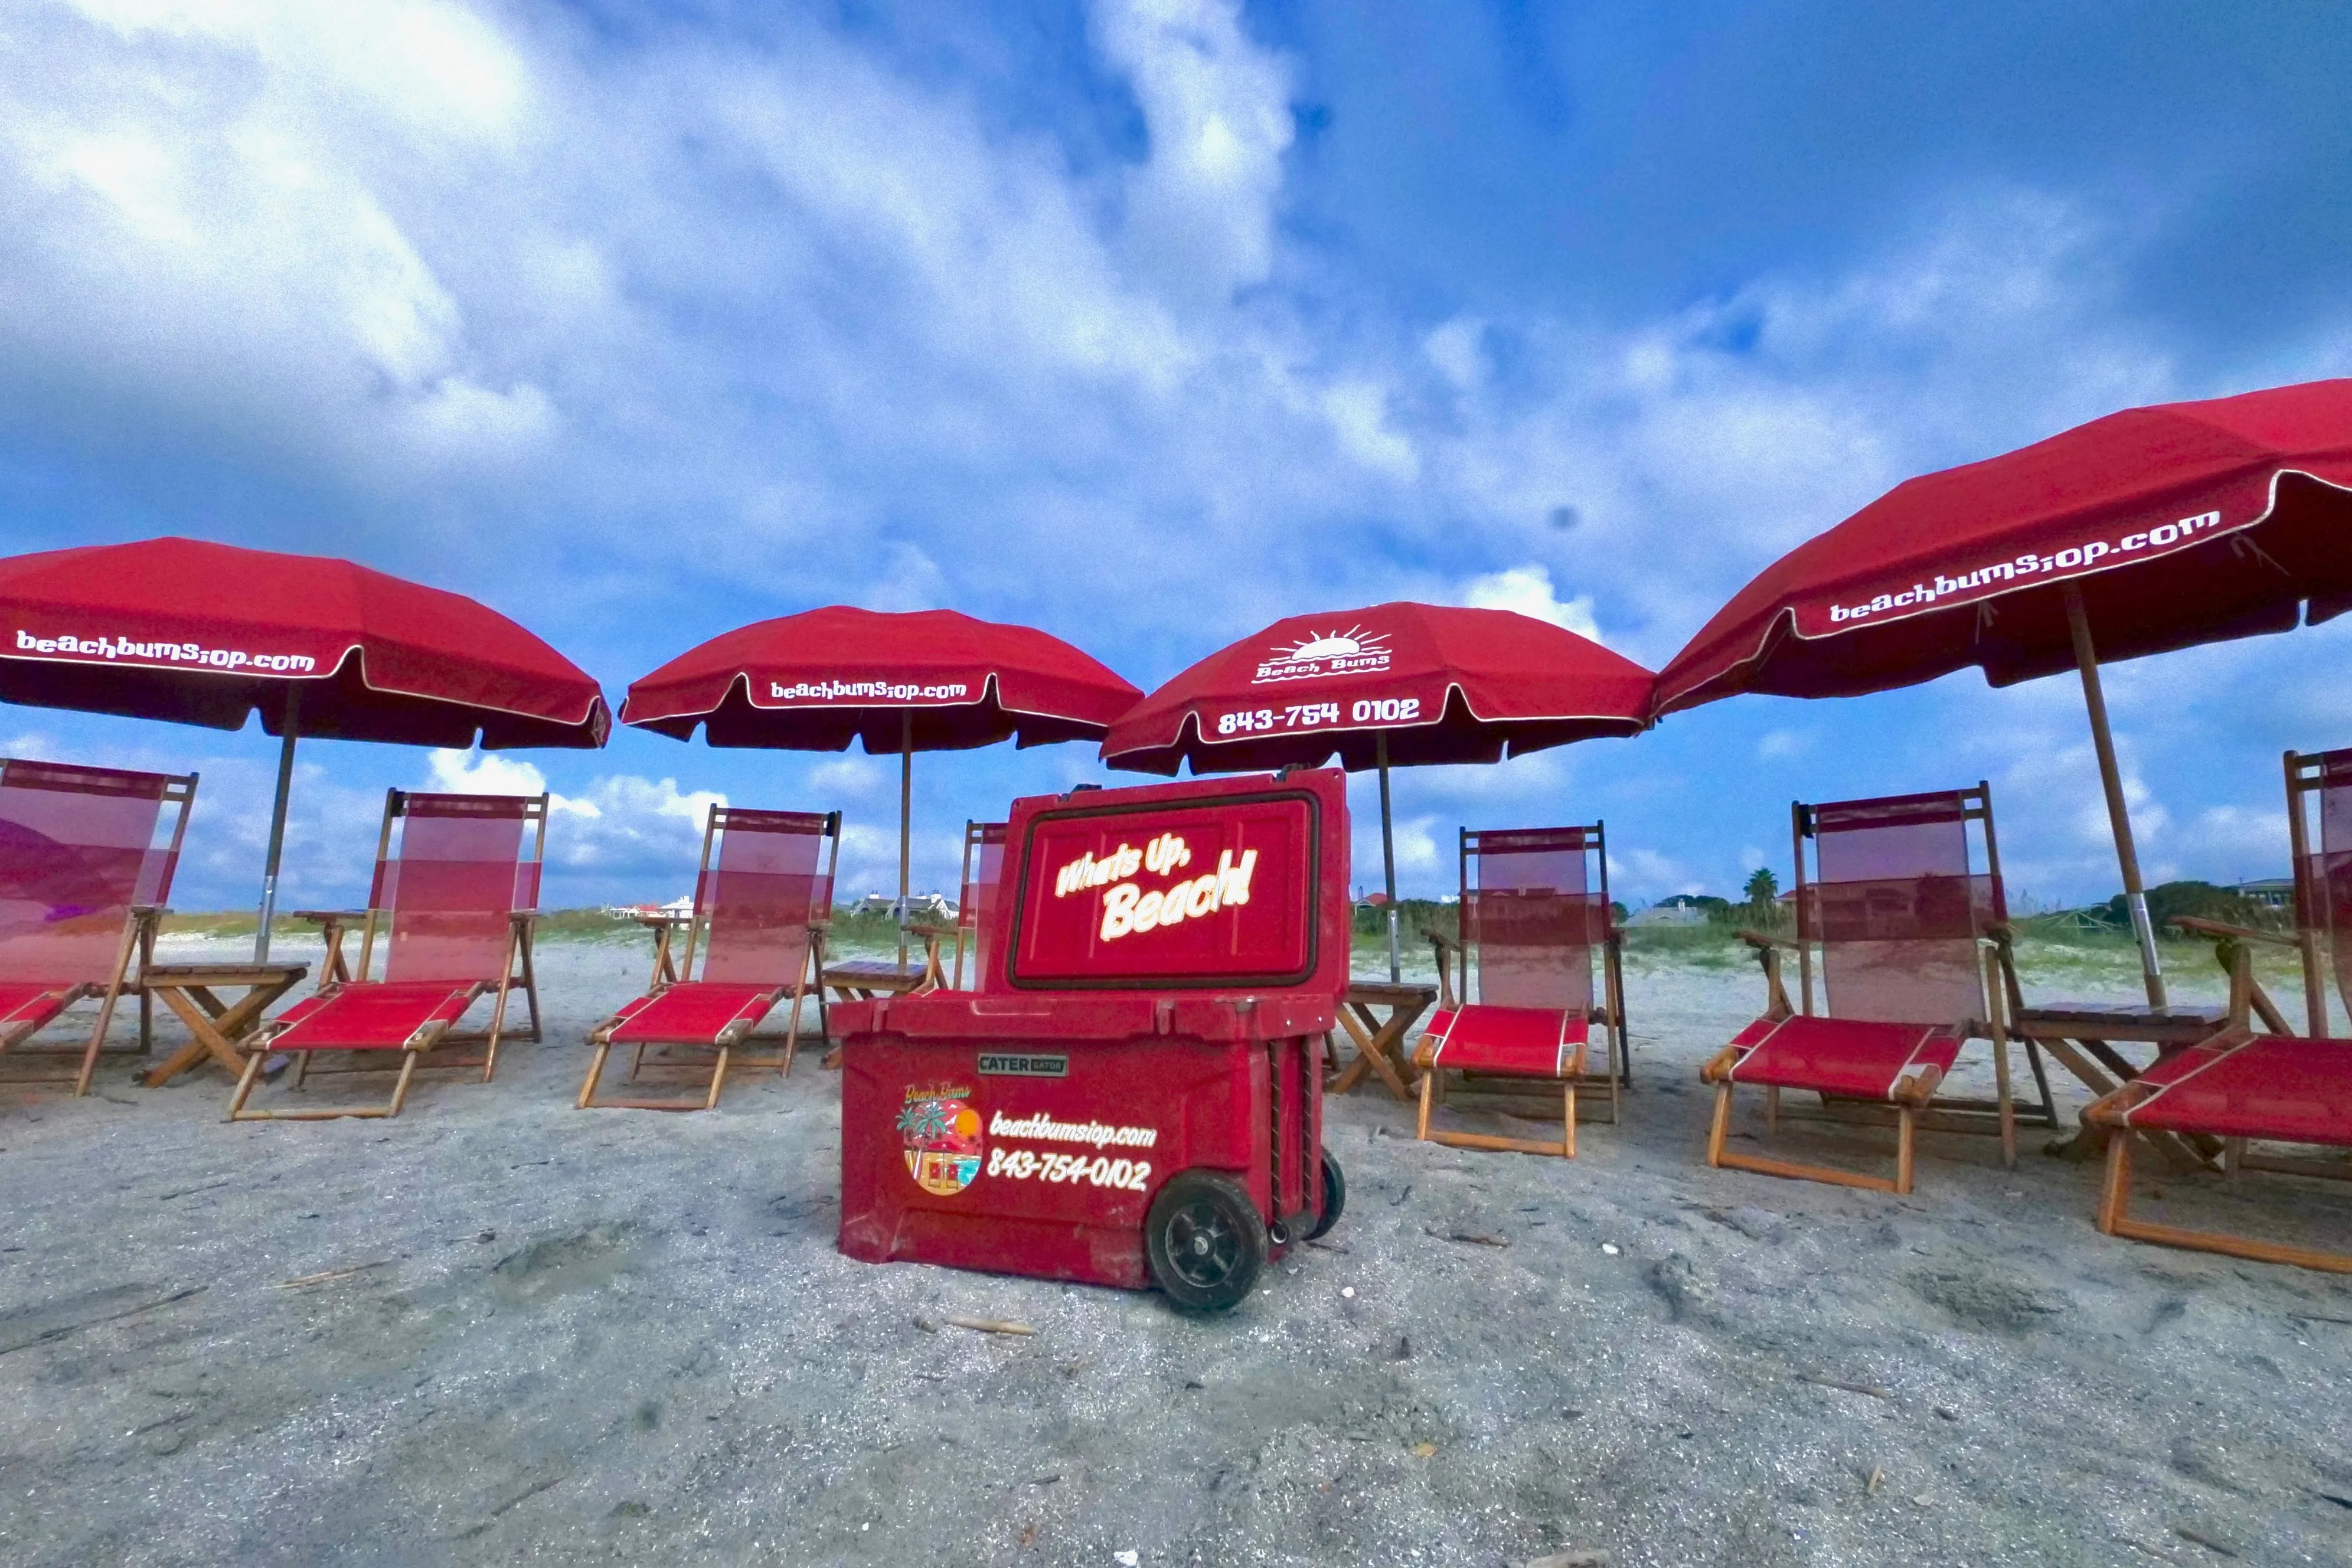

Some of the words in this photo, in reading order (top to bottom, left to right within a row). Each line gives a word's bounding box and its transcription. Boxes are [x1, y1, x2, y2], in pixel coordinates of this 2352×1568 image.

[1830, 511, 2221, 622] beachbumsiop.com
[17, 630, 316, 672] beachbumsiop.com
[1256, 663, 1320, 678] Beach
[1331, 655, 1391, 670] Bums
[770, 680, 967, 701] beachbumsiop.com
[1218, 701, 1340, 734] 843-754
[1351, 698, 1420, 722] 0102
[904, 1084, 936, 1104] Beach
[989, 1109, 1157, 1150] beachbumsiop.com
[986, 1146, 1152, 1192] 843-754-0102
